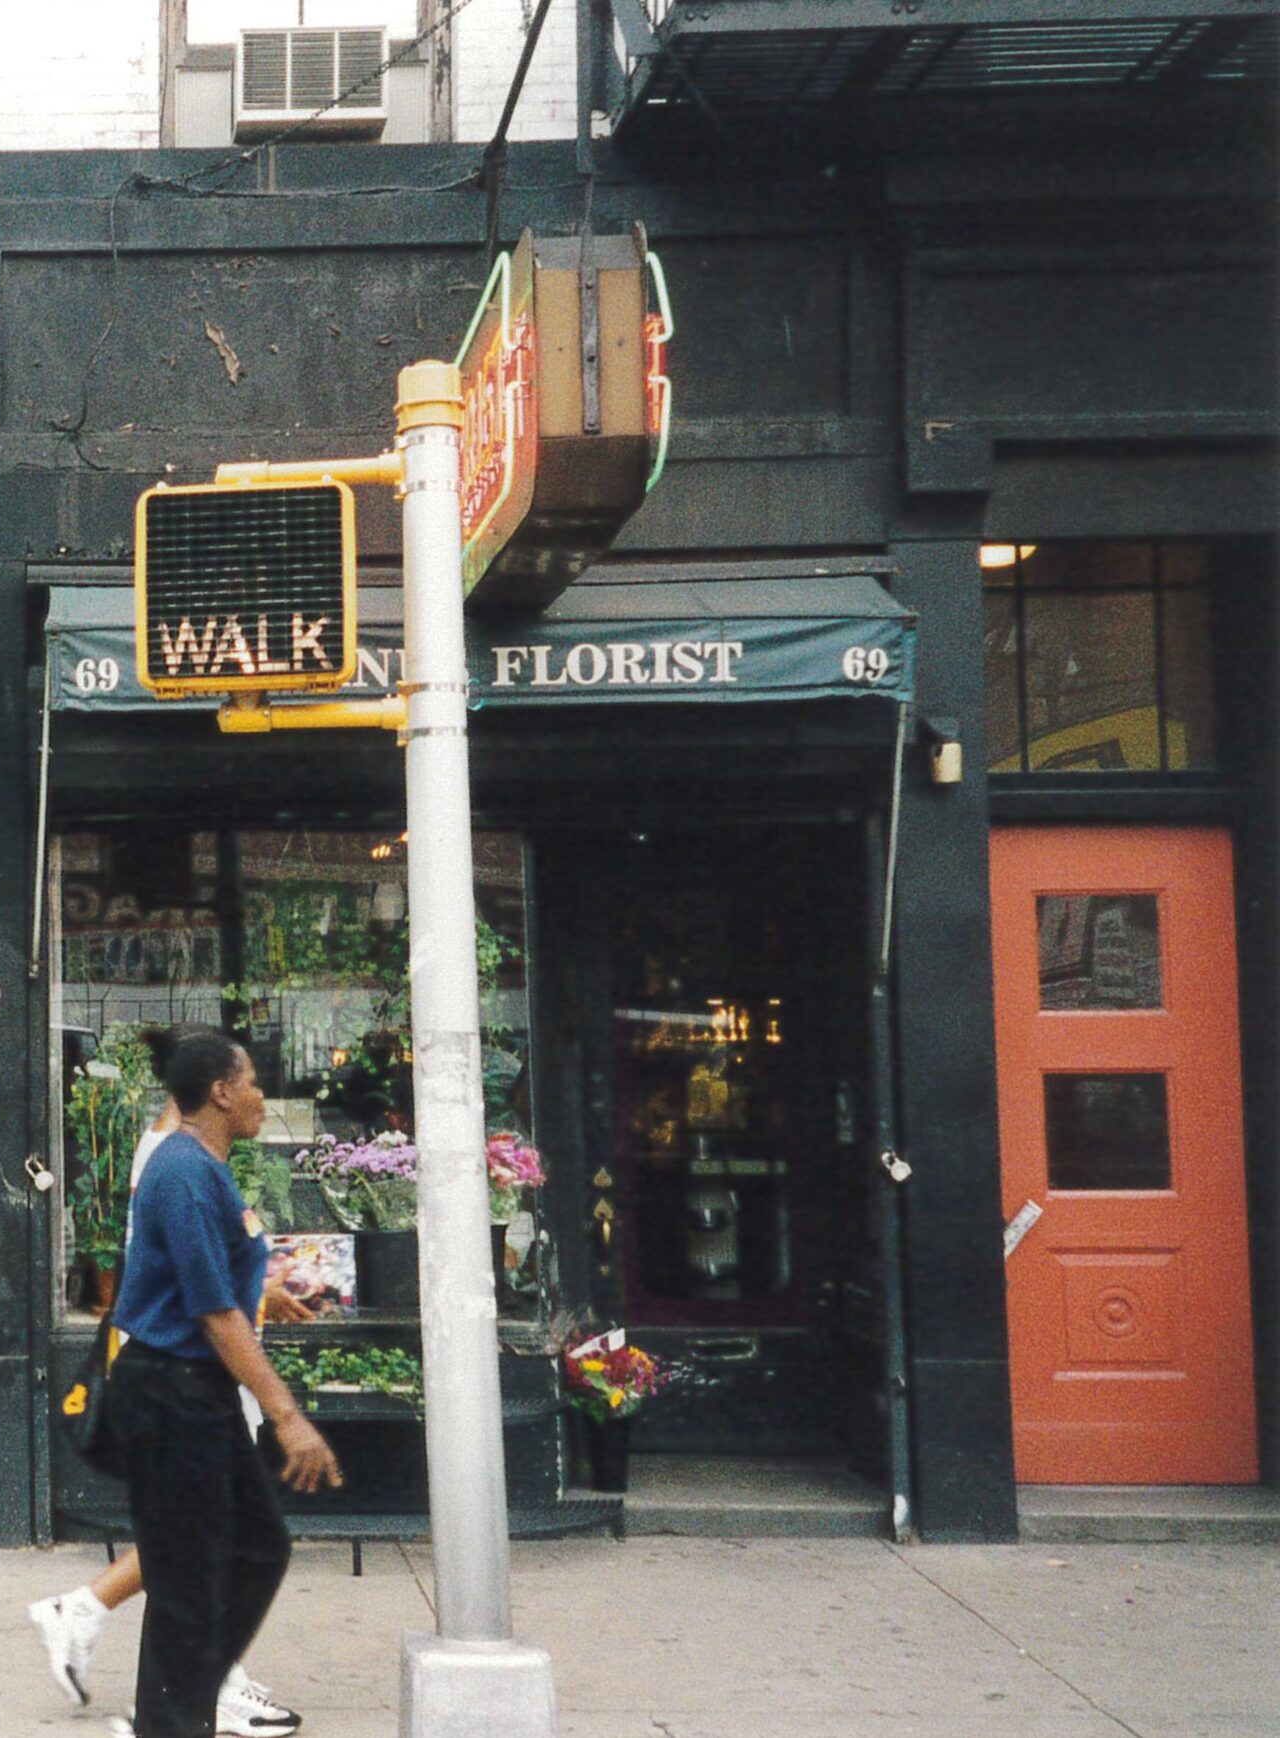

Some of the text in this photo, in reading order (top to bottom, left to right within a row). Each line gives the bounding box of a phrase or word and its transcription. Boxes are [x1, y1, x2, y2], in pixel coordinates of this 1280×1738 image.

[158, 613, 334, 675] WALK
[842, 646, 889, 683] 69
[75, 659, 118, 694] 69
[491, 642, 743, 688] FLORIST
